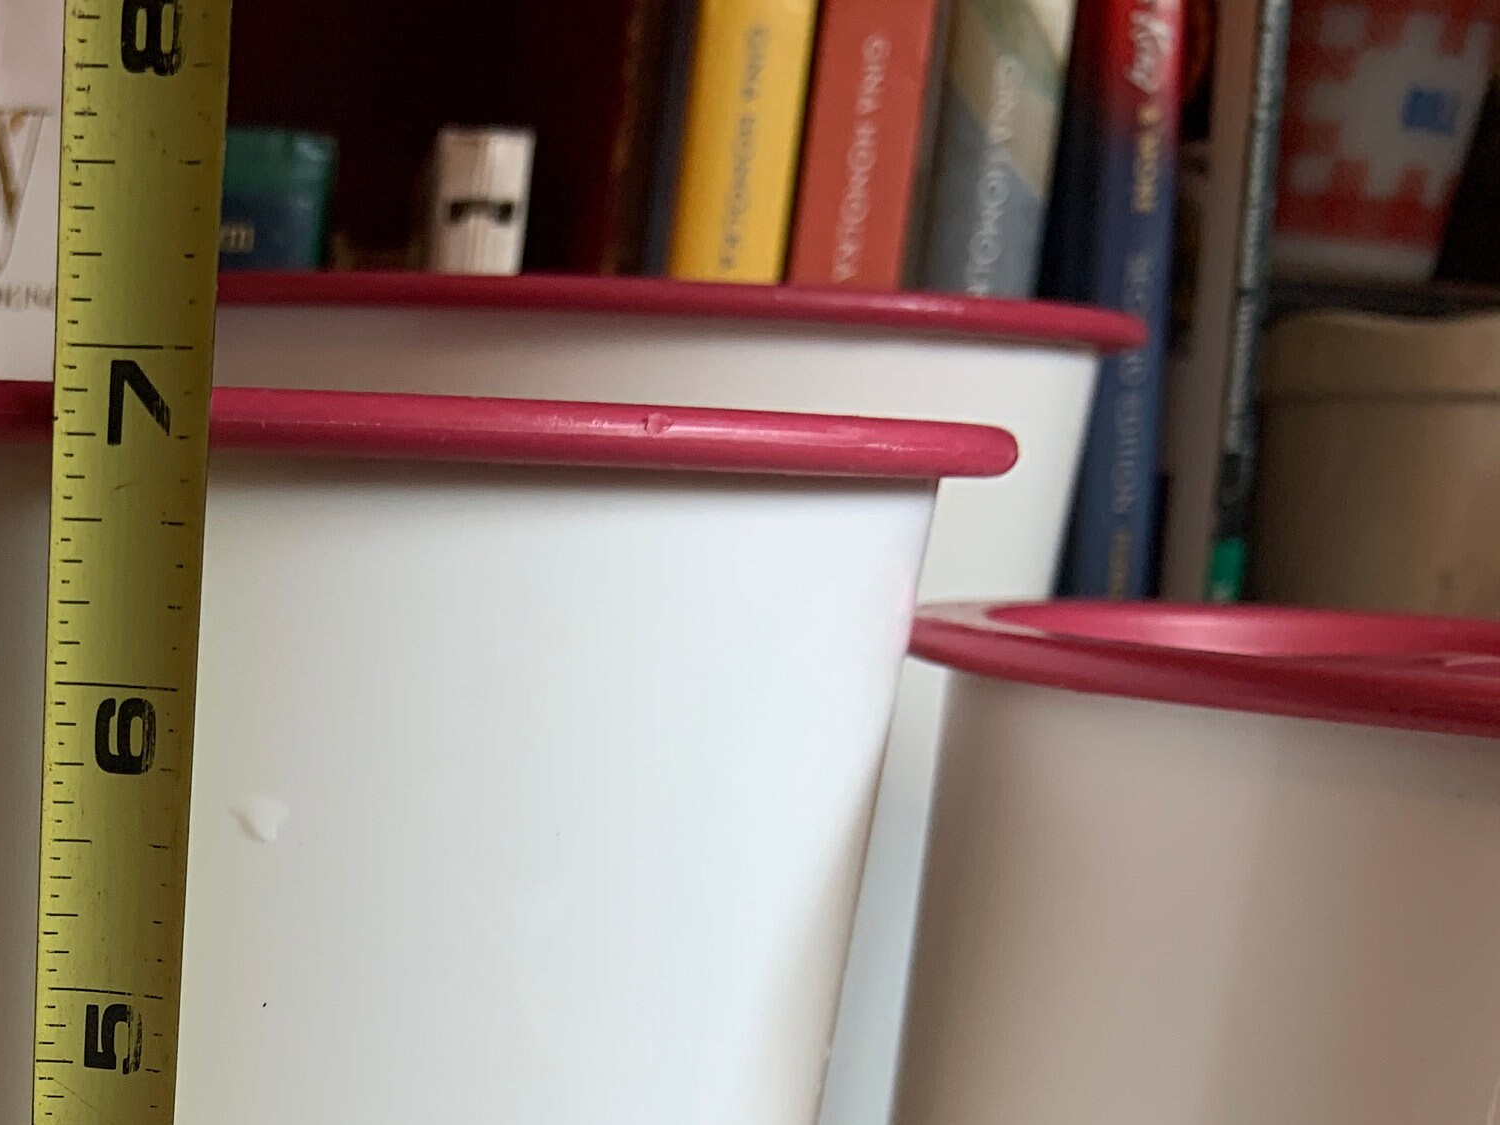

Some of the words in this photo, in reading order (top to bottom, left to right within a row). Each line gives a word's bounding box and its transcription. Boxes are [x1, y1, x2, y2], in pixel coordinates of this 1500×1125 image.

[120, 0, 182, 76] 8
[106, 360, 171, 445] 7
[94, 697, 156, 775] 6
[83, 1003, 142, 1075] 5
